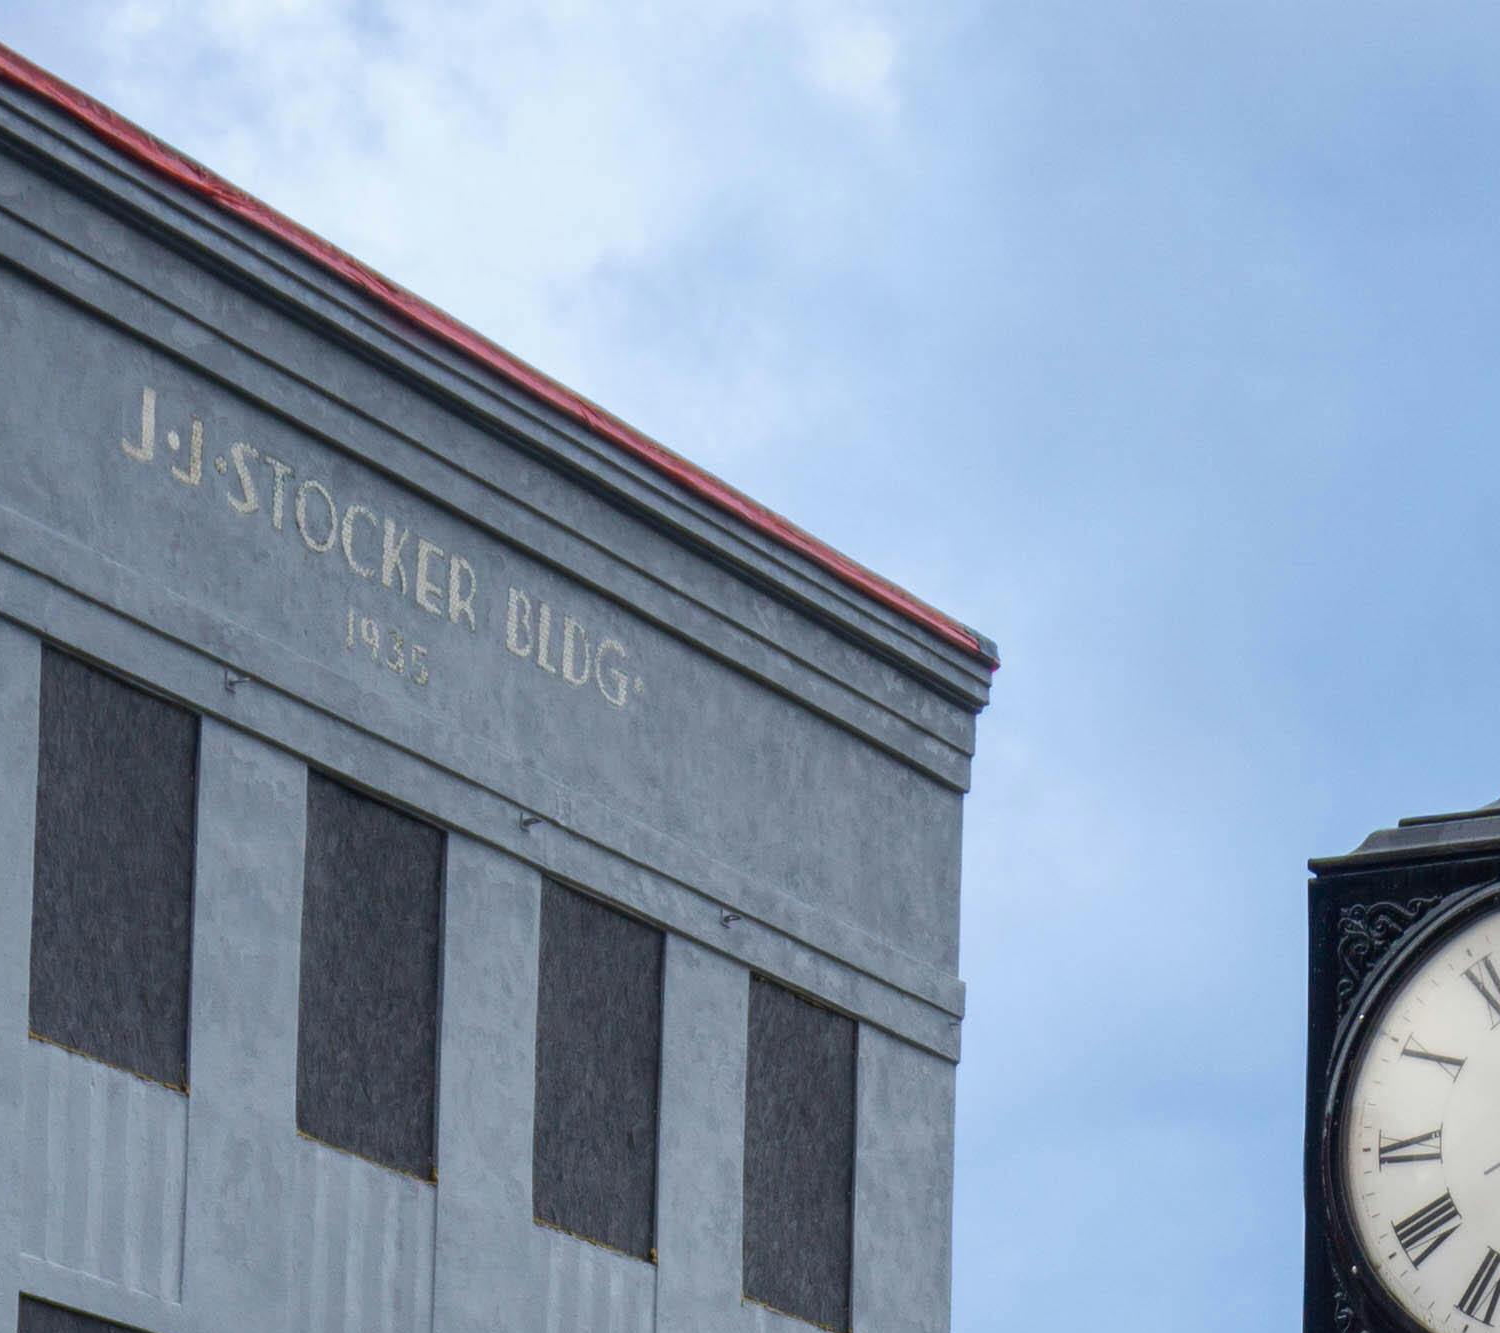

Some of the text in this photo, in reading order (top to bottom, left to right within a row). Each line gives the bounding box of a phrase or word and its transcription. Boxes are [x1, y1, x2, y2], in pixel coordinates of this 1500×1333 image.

[228, 441, 477, 632] STOCKER
[345, 607, 429, 688] 1935
[1400, 1034, 1467, 1082] X
[1379, 1122, 1443, 1171] IX
[1391, 1188, 1463, 1270] VIII
